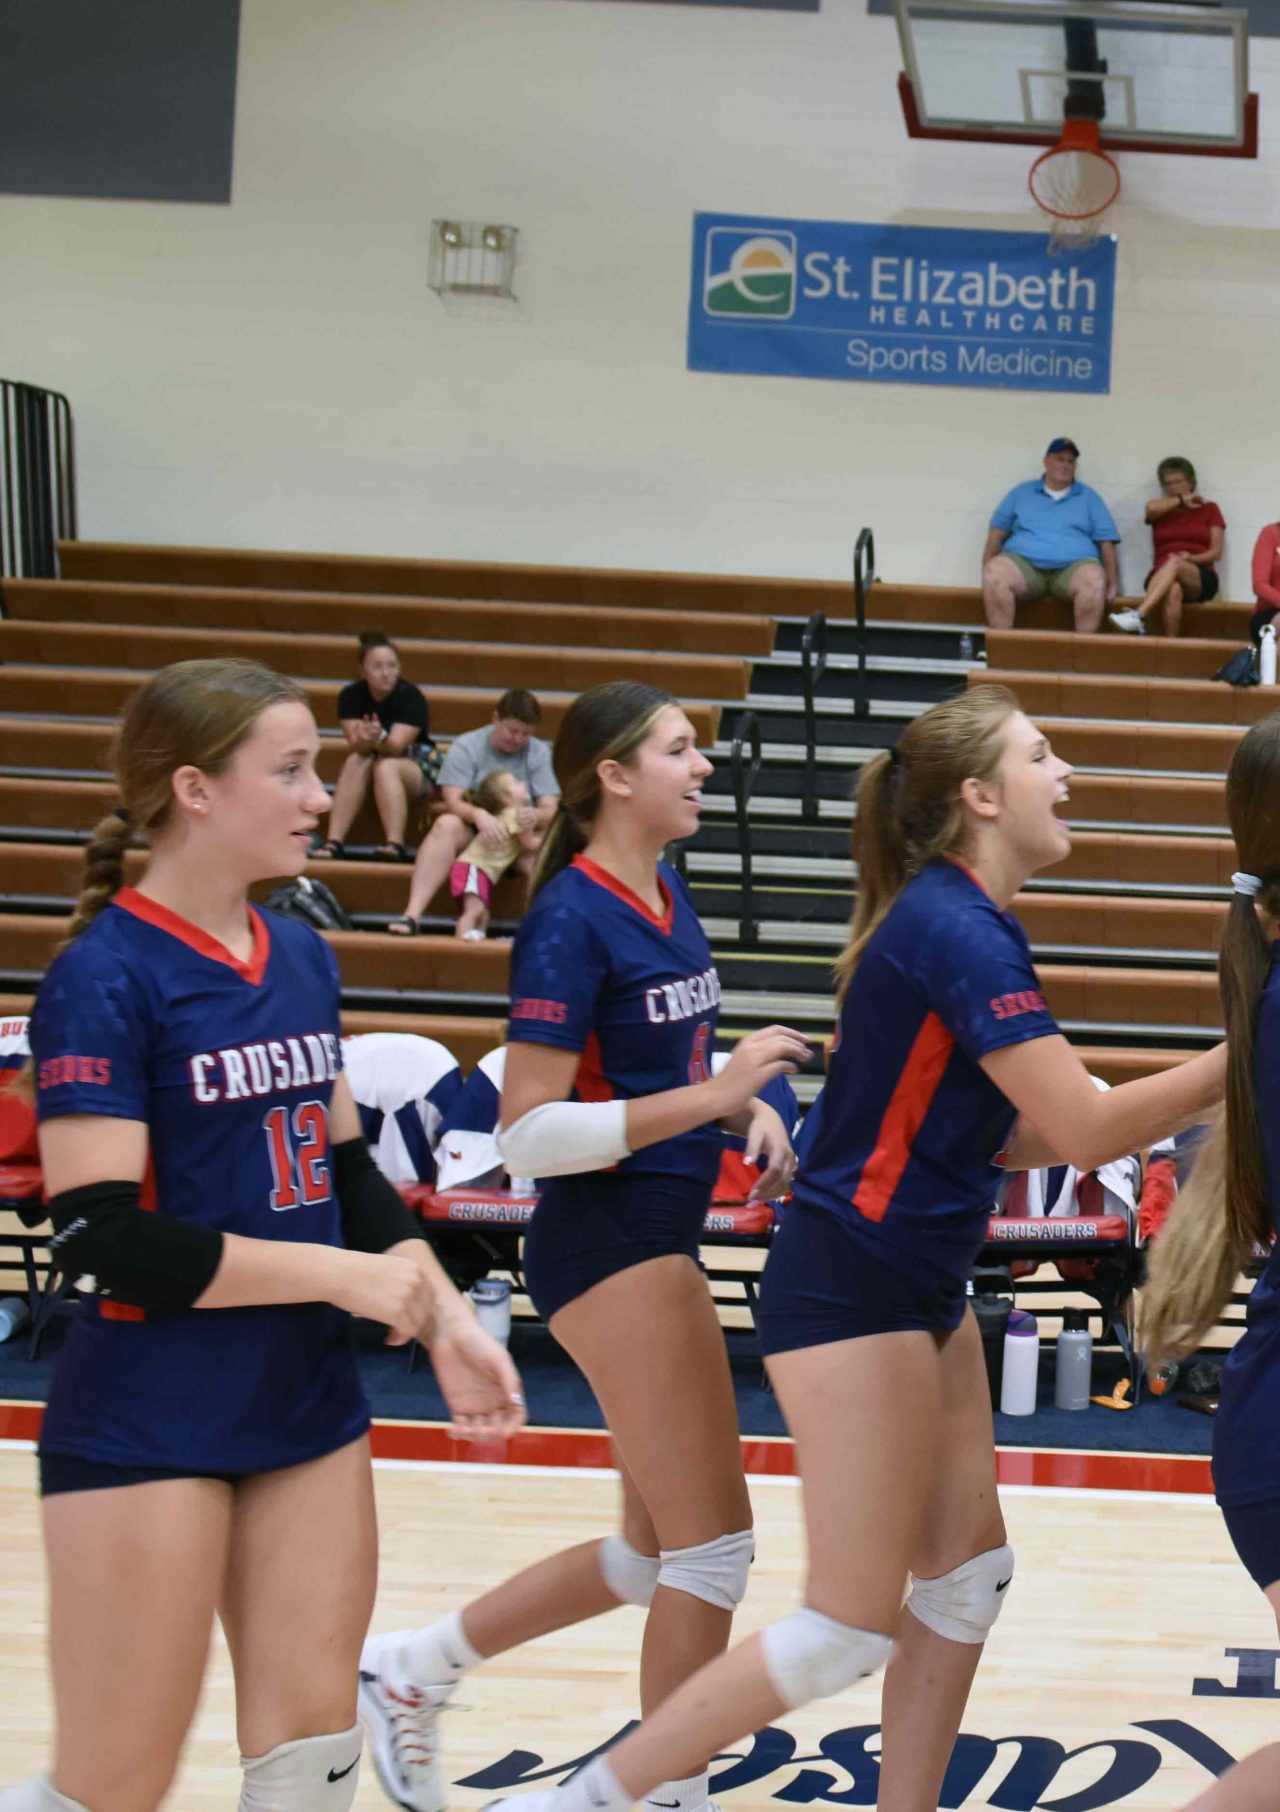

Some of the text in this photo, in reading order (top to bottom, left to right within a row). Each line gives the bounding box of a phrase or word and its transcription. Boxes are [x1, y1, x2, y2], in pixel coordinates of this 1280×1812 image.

[803, 251, 1098, 312] St. Elizabeth
[869, 305, 1096, 336] HEALTHCARE
[846, 337, 1094, 380] Sports Medicine
[262, 1099, 332, 1212] 12
[993, 1222, 1098, 1241] CRUSADERS
